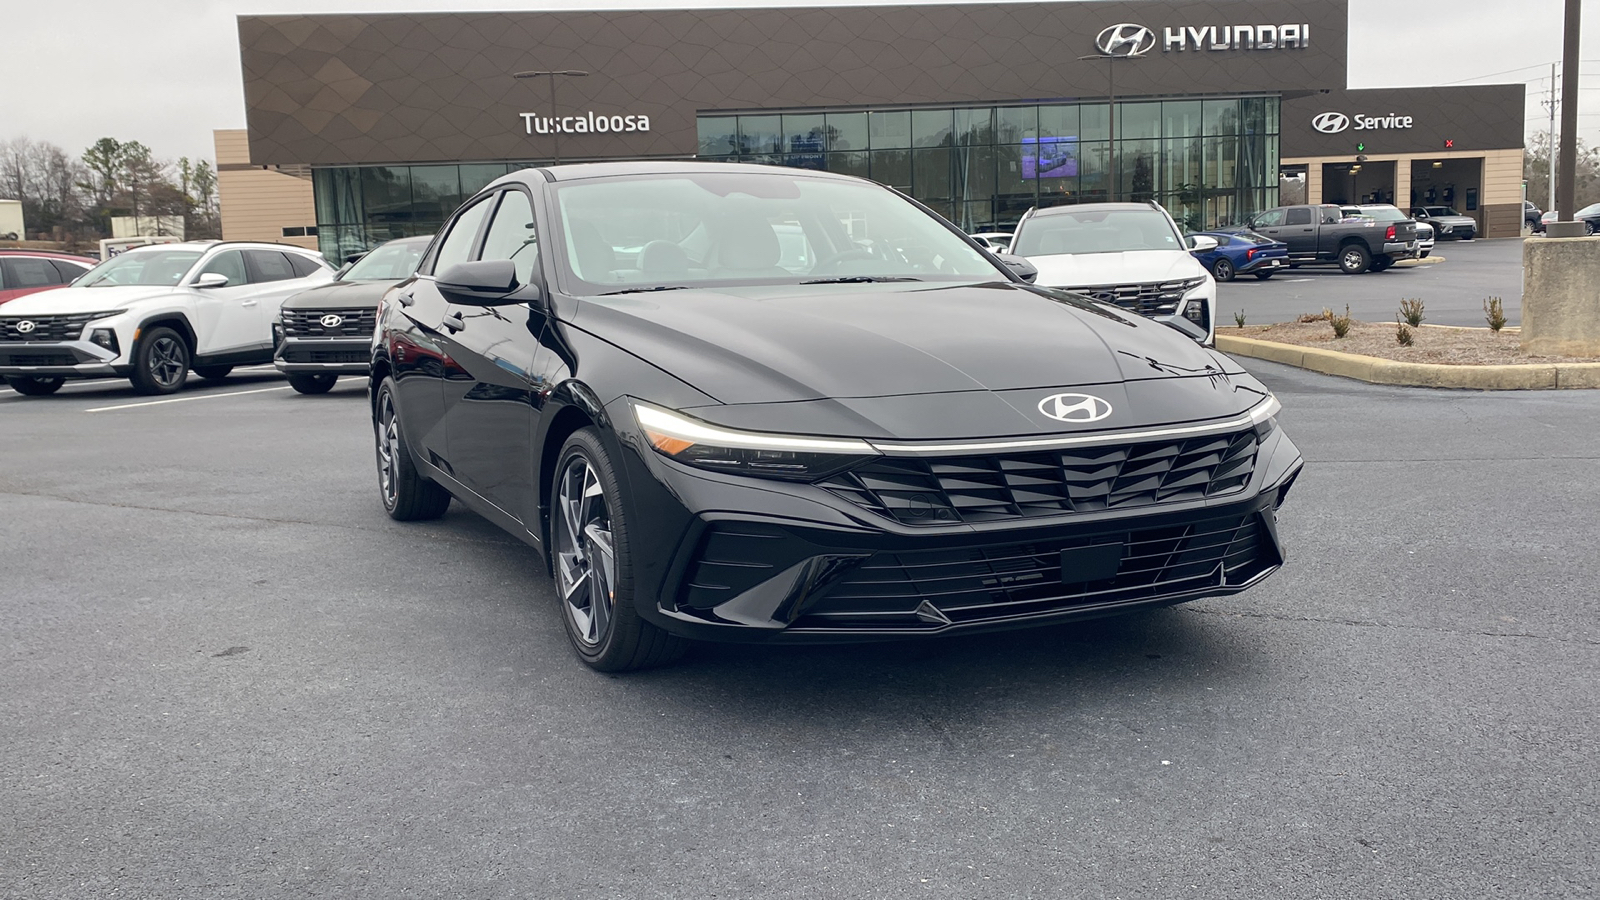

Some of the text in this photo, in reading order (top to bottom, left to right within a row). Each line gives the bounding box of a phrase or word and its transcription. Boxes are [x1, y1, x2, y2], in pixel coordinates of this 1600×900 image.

[1162, 23, 1310, 51] HYUNDAI
[519, 111, 650, 134] Tuscaloosa
[1353, 113, 1413, 130] Service
